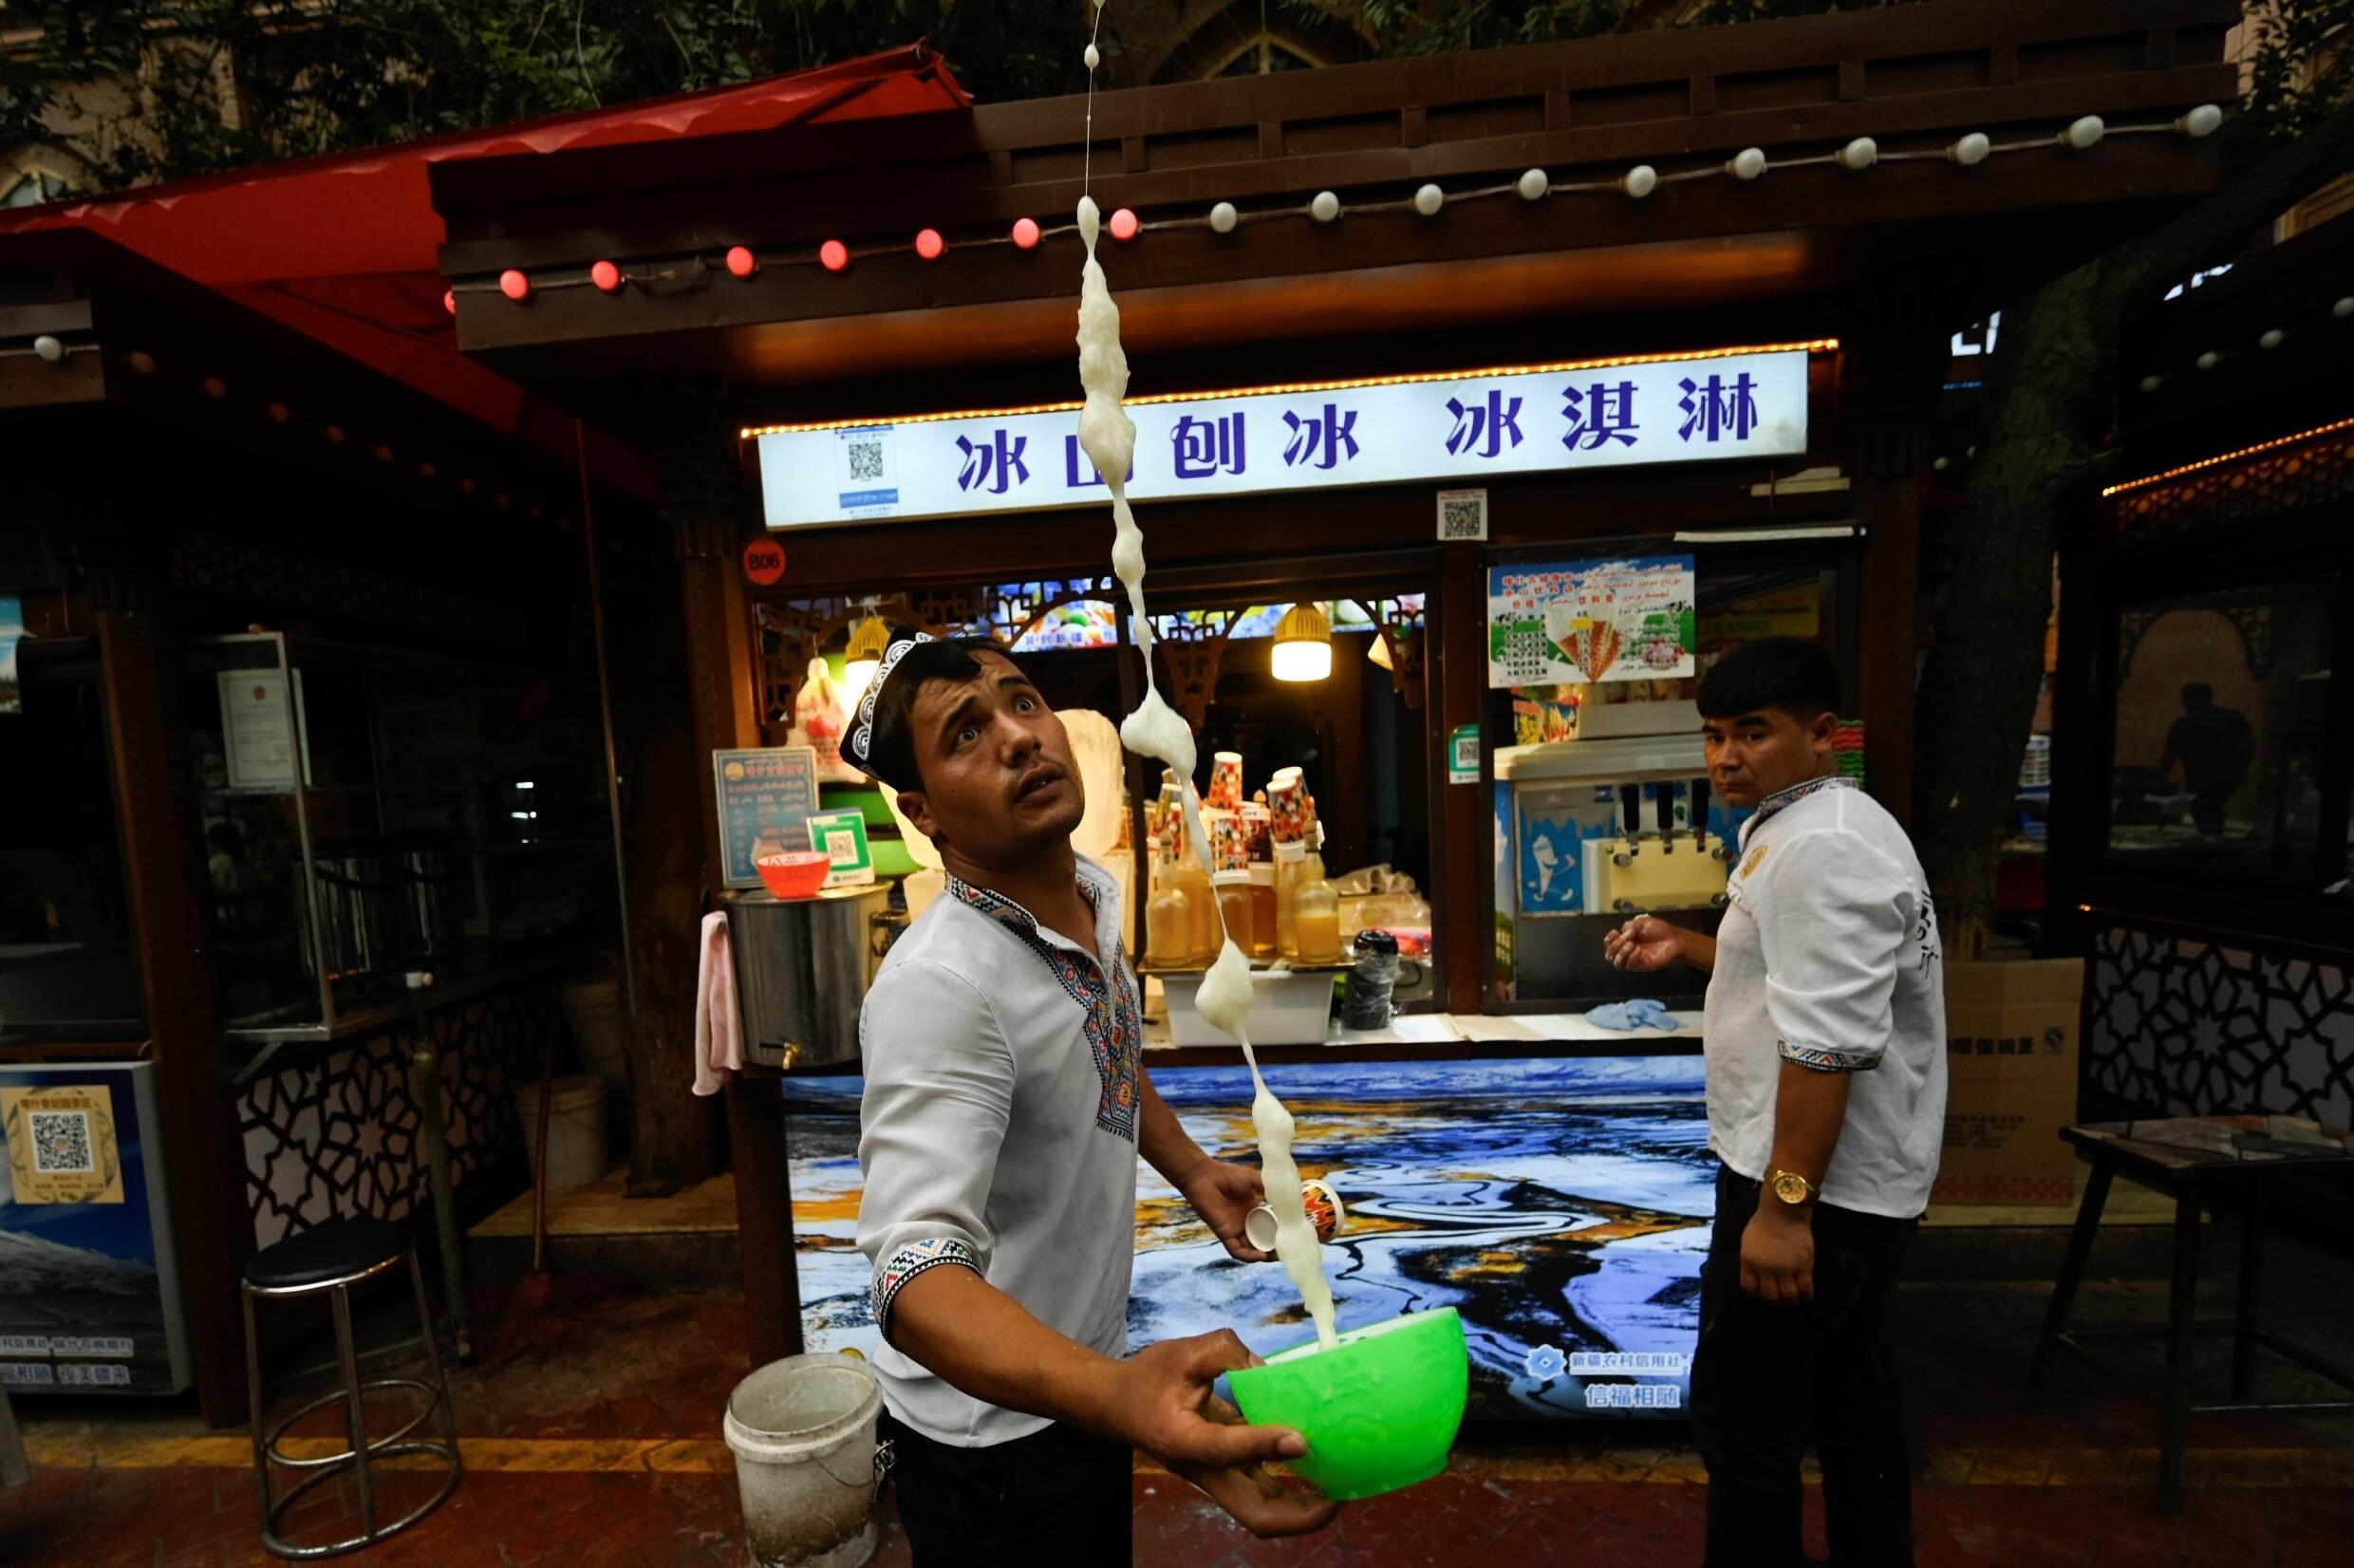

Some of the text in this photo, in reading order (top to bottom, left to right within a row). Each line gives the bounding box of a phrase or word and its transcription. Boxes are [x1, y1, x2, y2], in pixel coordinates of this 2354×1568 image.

[1445, 372, 1758, 458] 冰淇淋
[748, 552, 780, 570] B06
[1571, 1353, 1680, 1368] 新疆农村信用社
[1586, 1385, 1679, 1407] 信福相随
